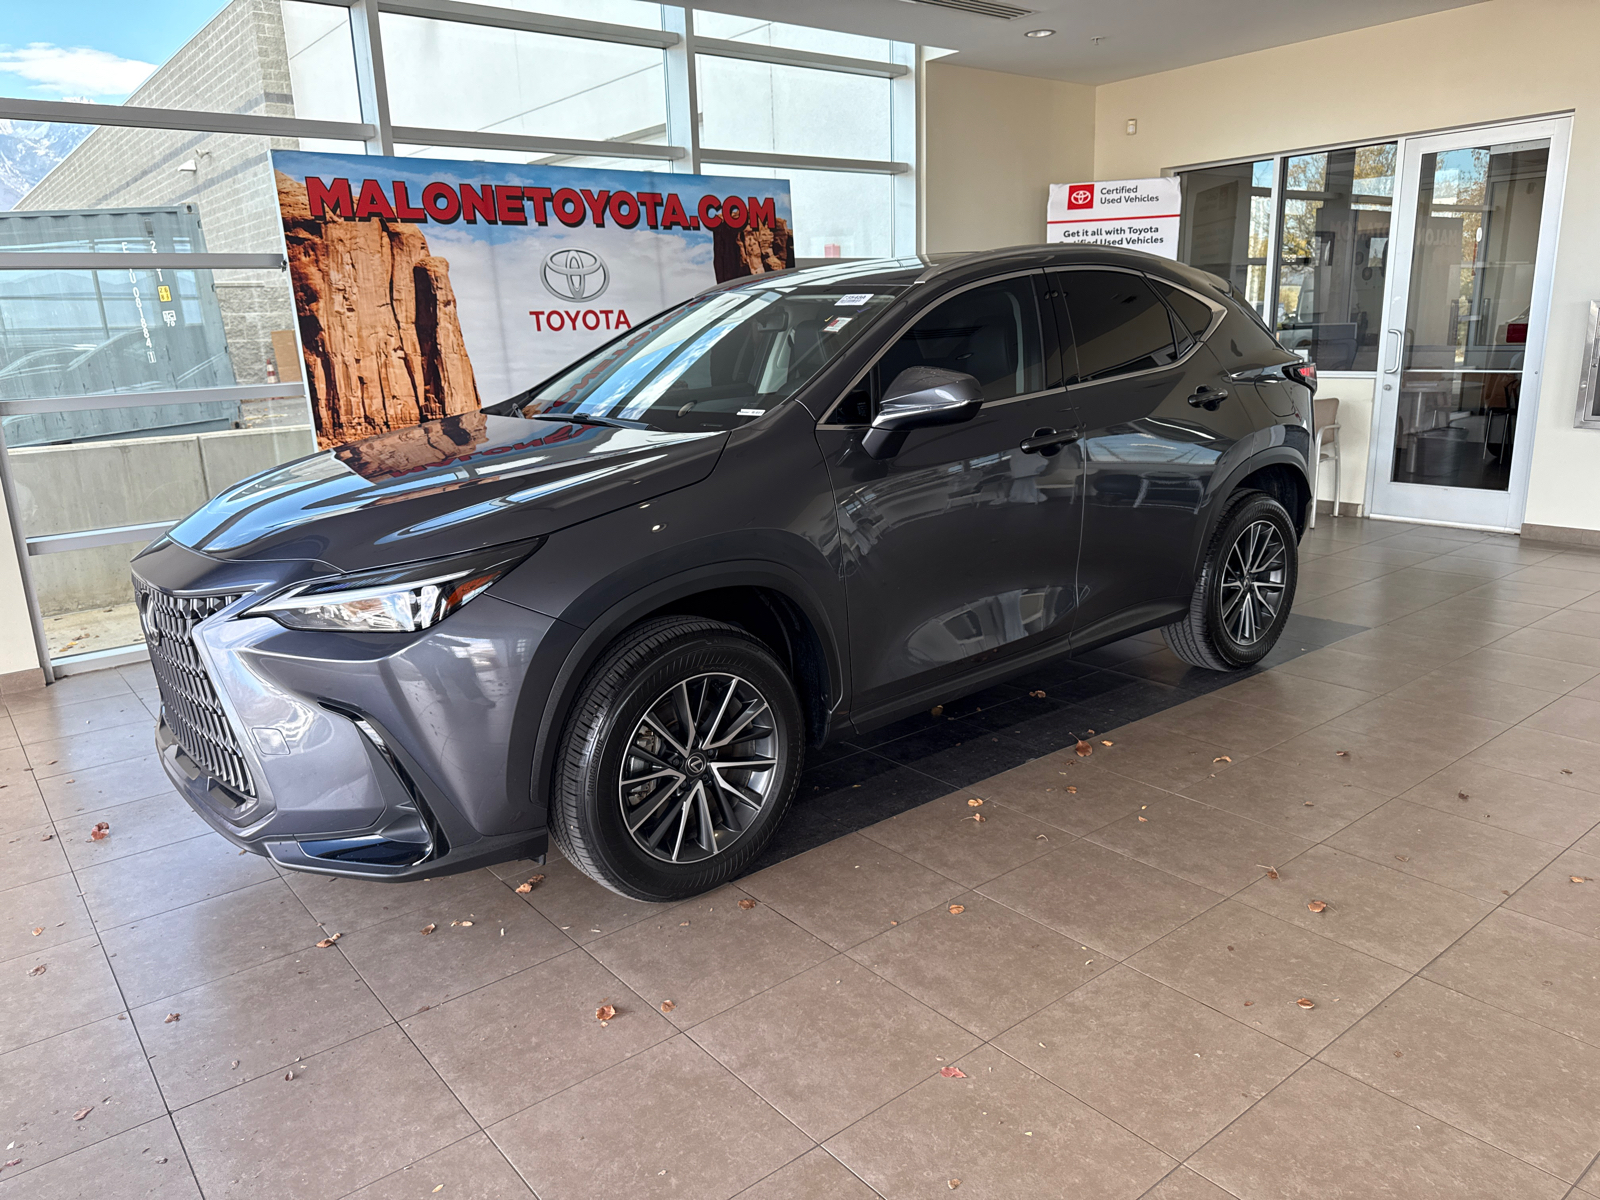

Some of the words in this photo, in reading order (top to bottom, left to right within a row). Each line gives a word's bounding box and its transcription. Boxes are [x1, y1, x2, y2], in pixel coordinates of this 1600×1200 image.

[1100, 185, 1138, 195] Certified
[304, 175, 777, 230] MALONETOYOTA.COM
[1100, 196, 1122, 205] Used
[1123, 194, 1160, 204] Vehicles
[1063, 230, 1081, 238] Get
[1082, 229, 1089, 237] it
[1090, 228, 1103, 236] all
[1104, 227, 1126, 236] with
[1127, 226, 1159, 236] Toyota
[1100, 237, 1124, 245] Used
[1125, 236, 1164, 245] Vehicles
[529, 309, 632, 333] TOYOTA
